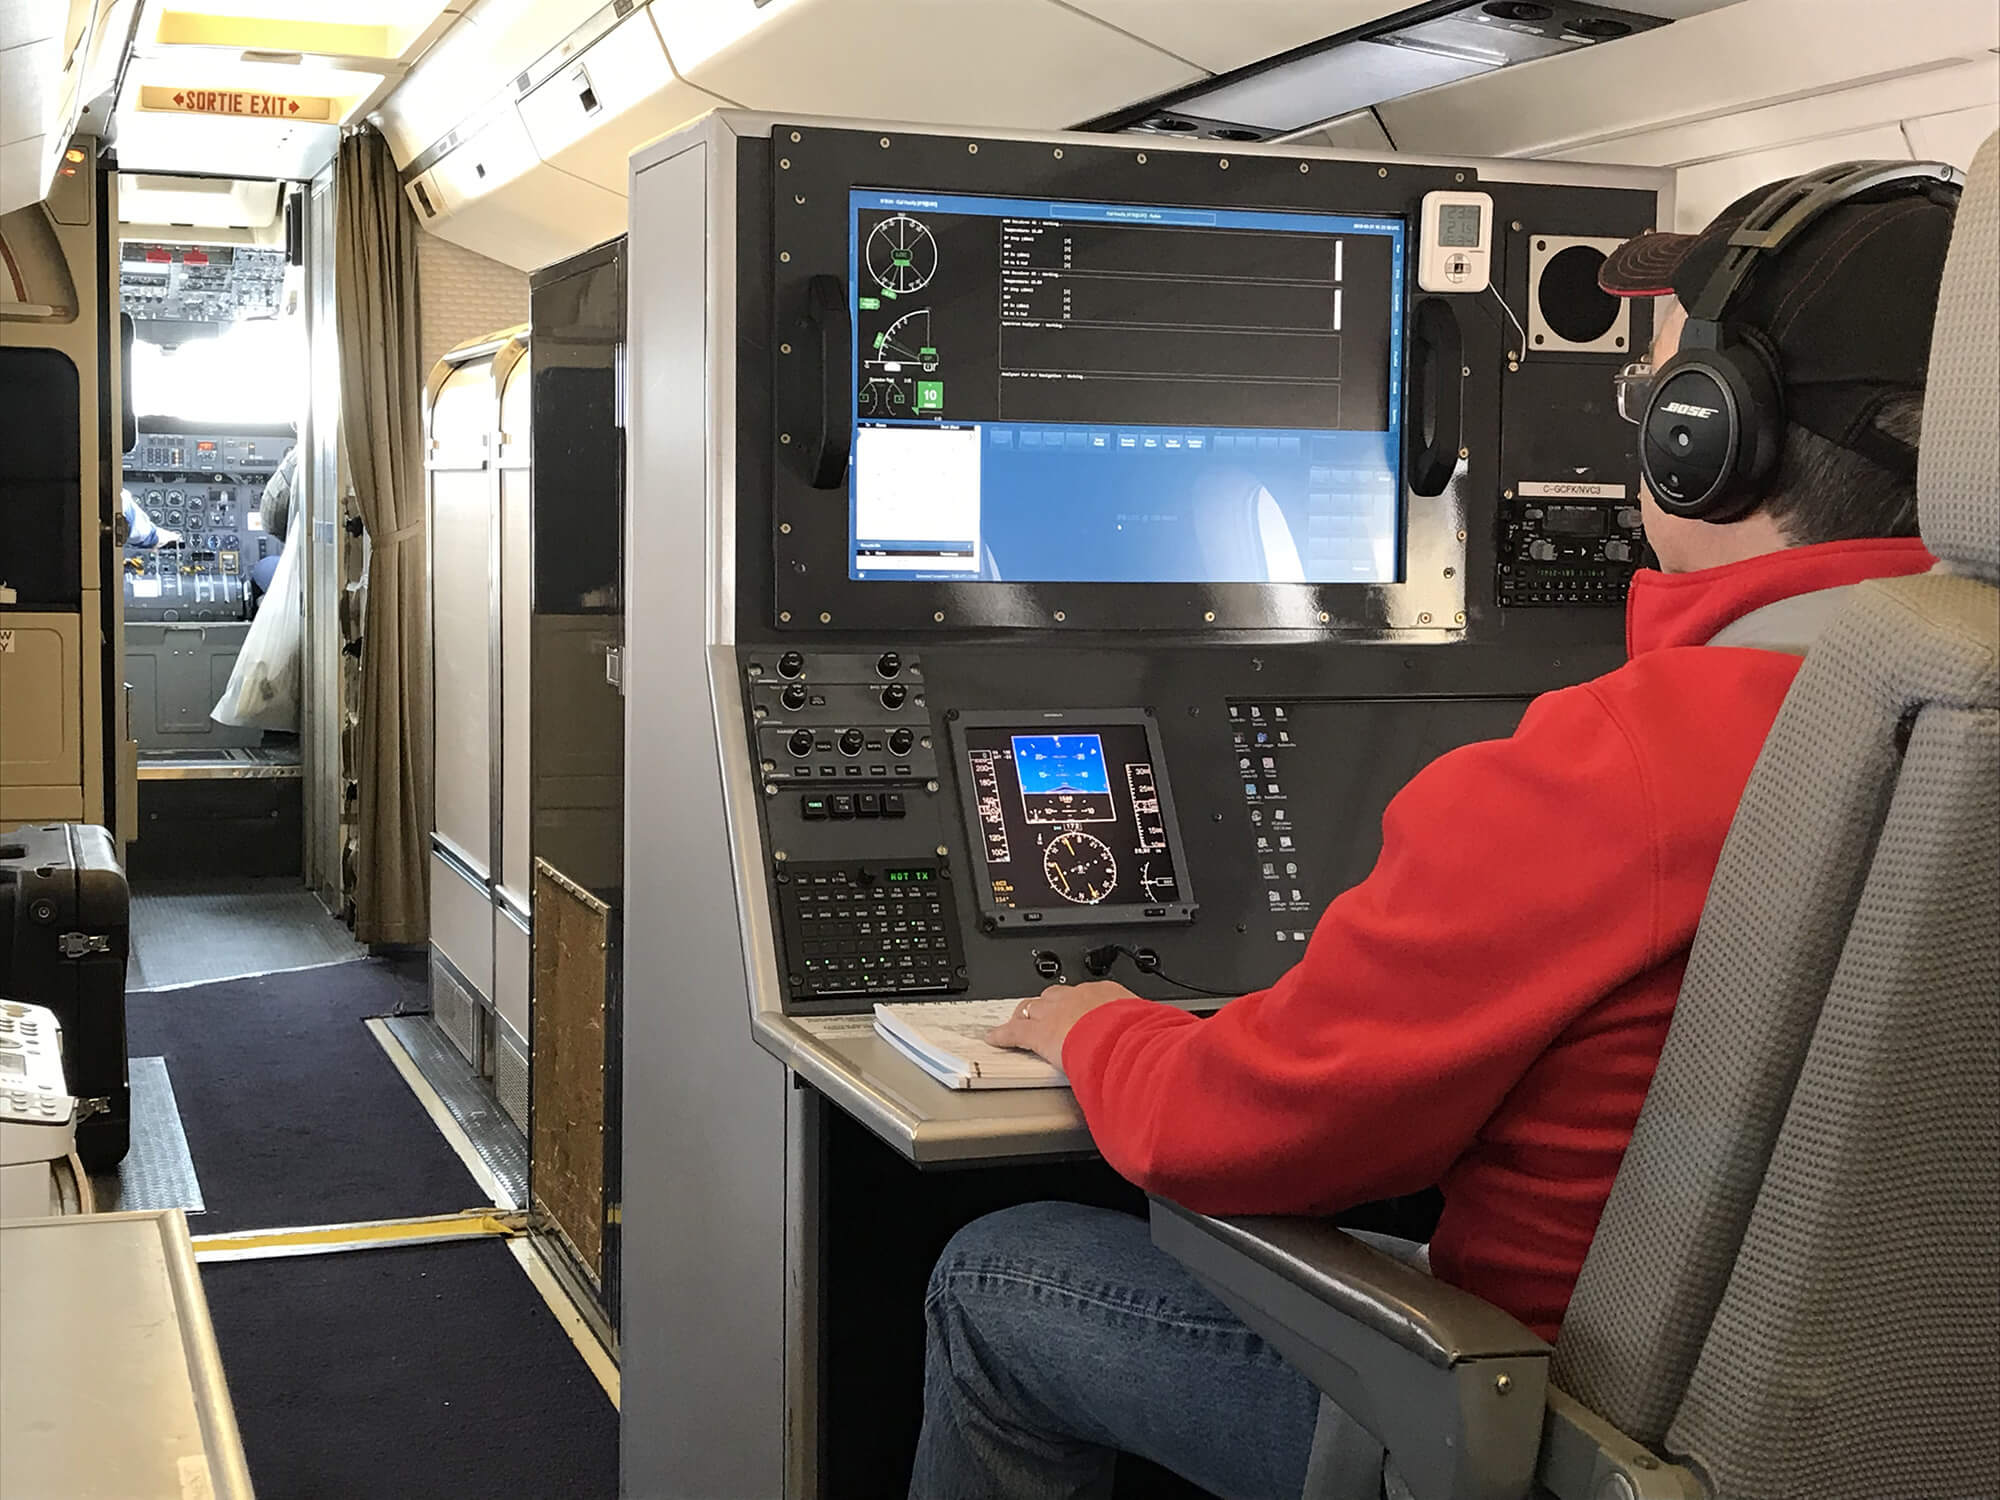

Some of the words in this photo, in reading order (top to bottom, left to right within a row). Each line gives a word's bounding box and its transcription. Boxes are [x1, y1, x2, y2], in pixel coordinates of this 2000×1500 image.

[186, 90, 243, 112] SORTIE
[250, 95, 286, 115] EXIT
[924, 389, 937, 401] 10
[1660, 401, 1719, 419] BOSE
